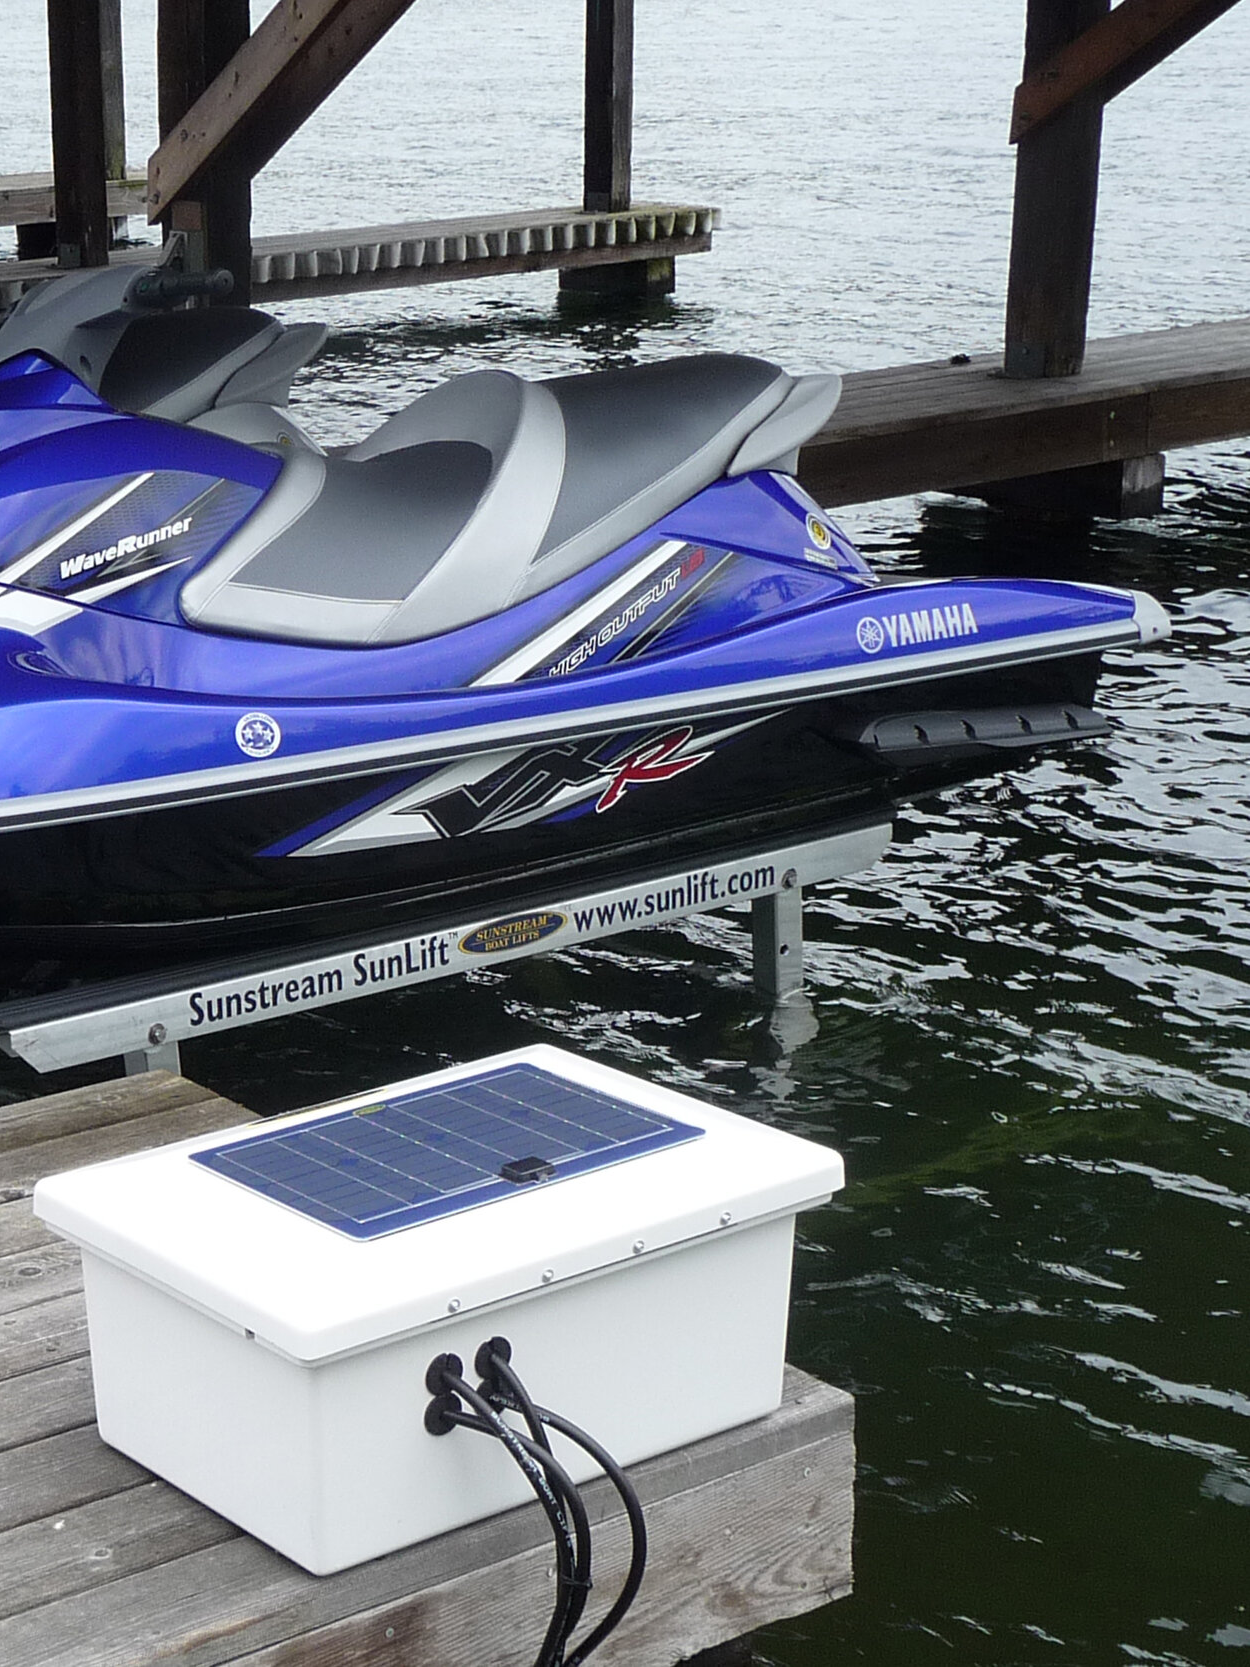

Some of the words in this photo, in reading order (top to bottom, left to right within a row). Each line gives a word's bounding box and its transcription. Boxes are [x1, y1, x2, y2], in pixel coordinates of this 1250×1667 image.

[59, 516, 193, 580] WaveRunner
[597, 567, 681, 647] OUTPUT
[881, 603, 979, 648] YAMAHA
[573, 865, 776, 933] www.sunlift.com
[485, 936, 509, 951] BOAT
[512, 929, 540, 945] LIFTS
[189, 968, 344, 1027] Sunstream
